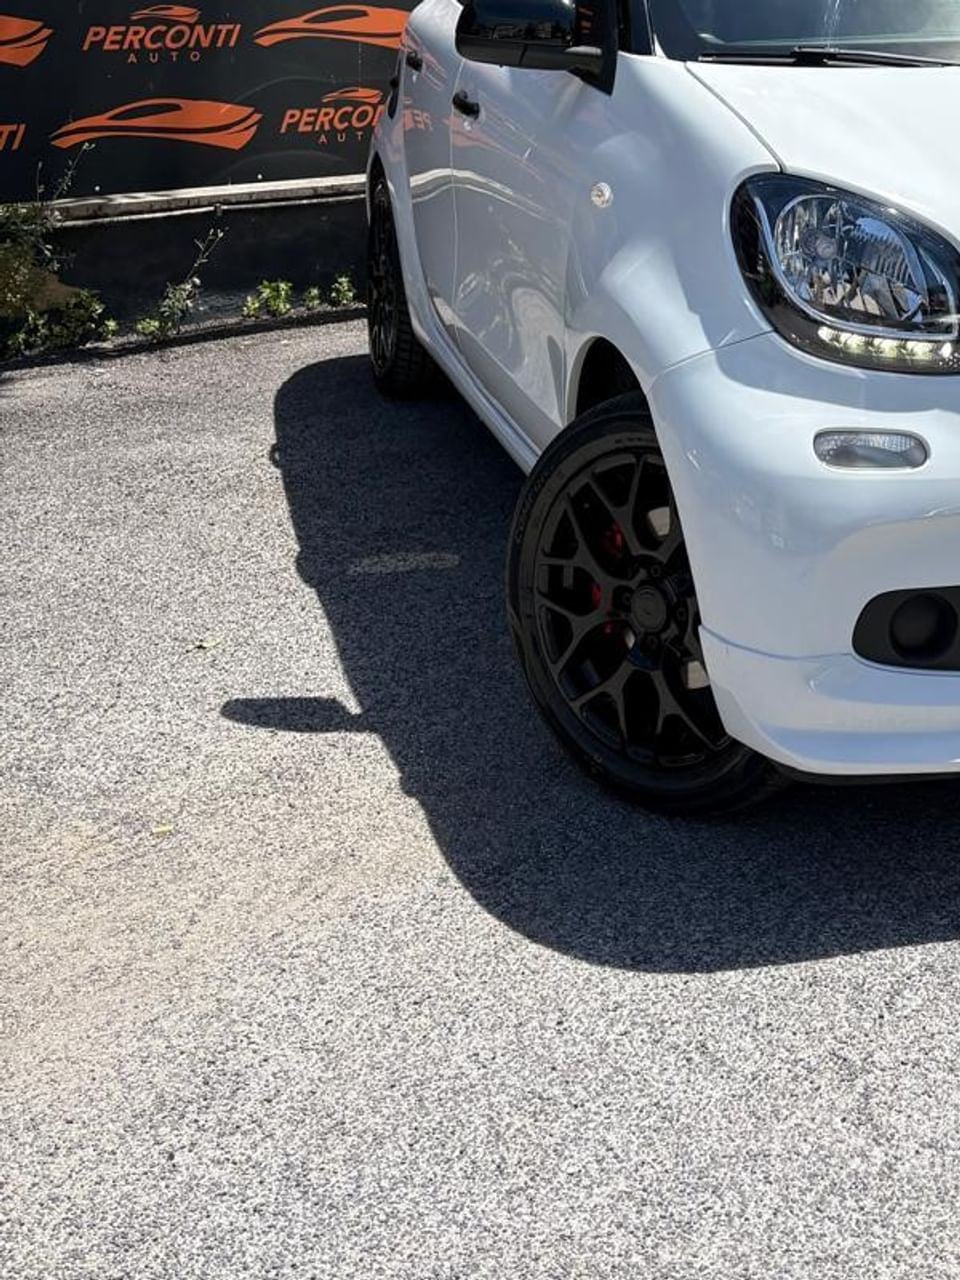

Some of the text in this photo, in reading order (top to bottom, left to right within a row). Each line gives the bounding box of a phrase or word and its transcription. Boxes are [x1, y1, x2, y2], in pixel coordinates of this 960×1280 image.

[84, 23, 241, 51] PERCONTI
[127, 51, 200, 64] AUTO
[318, 132, 364, 144] AUT
